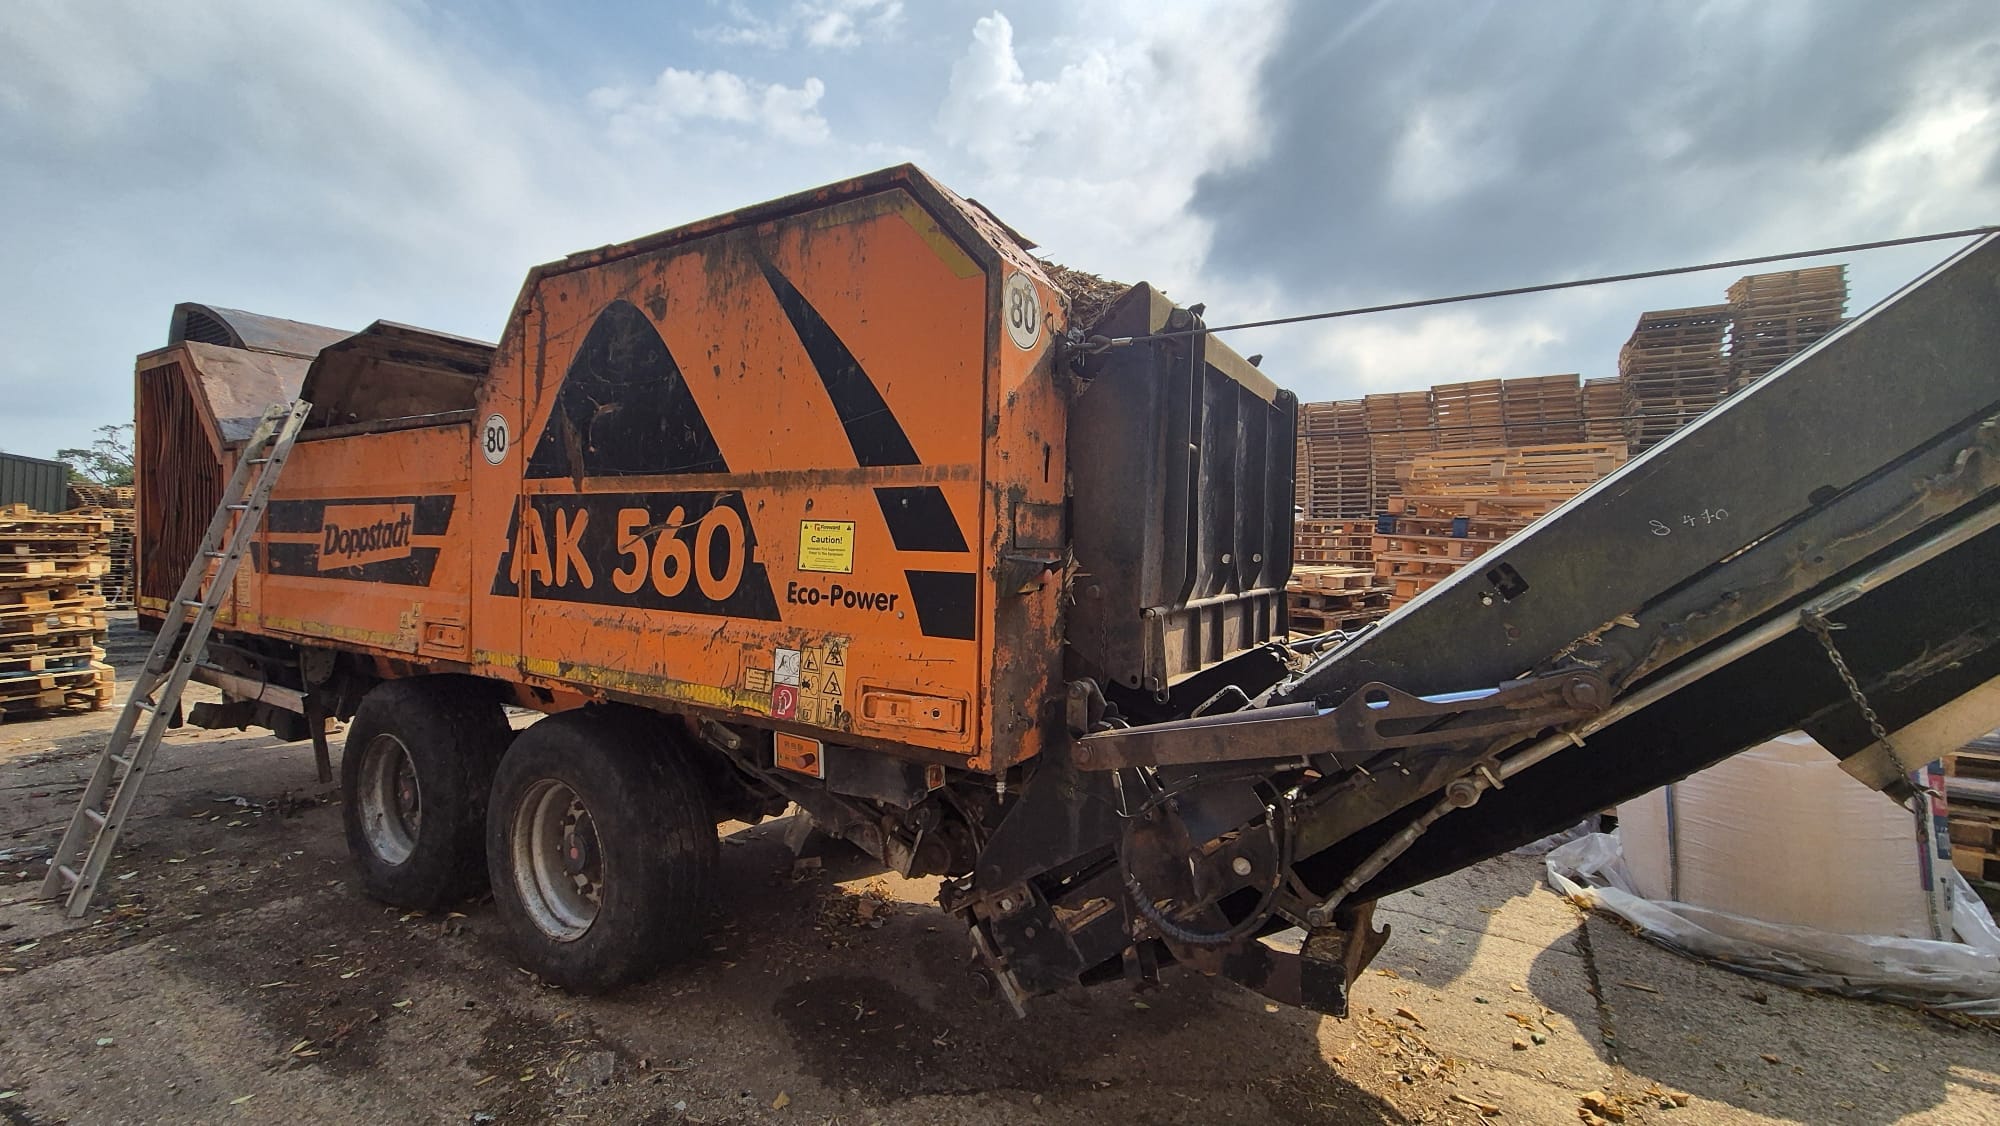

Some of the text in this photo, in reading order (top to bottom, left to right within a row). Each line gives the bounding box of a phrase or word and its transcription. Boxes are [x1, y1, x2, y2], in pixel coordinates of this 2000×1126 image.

[1011, 287, 1035, 334] 80
[487, 426, 505, 452] 80
[323, 512, 412, 559] Doppstadt
[510, 505, 745, 601] AK 560
[811, 535, 843, 545] Caution!
[787, 581, 899, 611] Eco-Power
